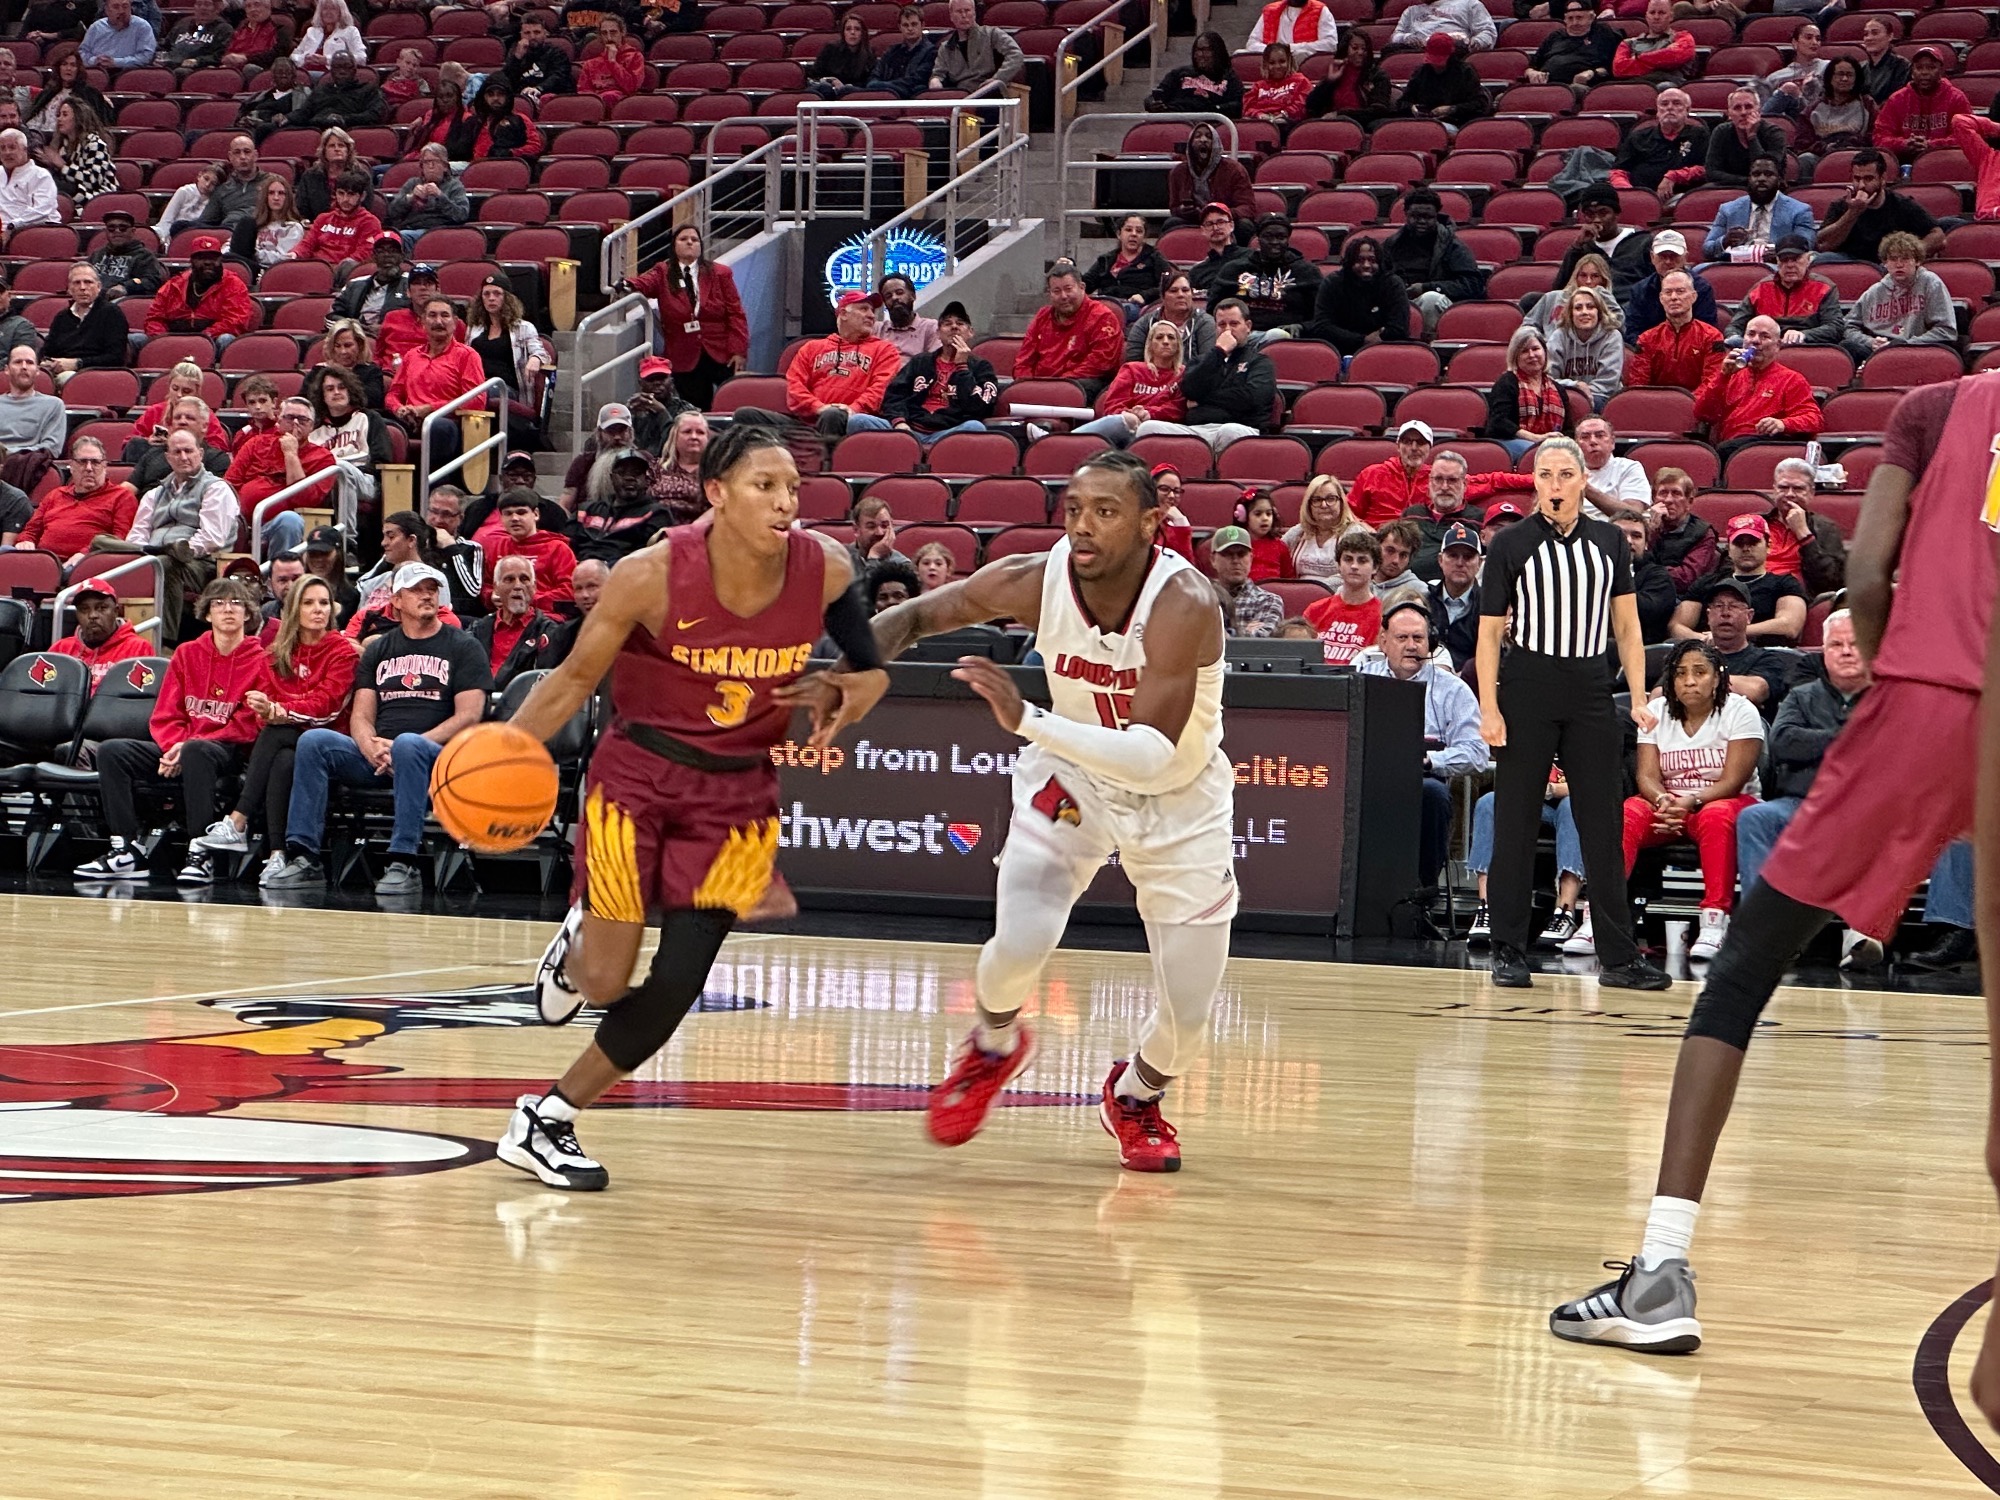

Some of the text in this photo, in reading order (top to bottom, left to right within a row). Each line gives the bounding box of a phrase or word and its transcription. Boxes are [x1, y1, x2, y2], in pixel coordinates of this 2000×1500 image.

[1869, 293, 1926, 323] LOUISVILLE
[1328, 621, 1358, 635] 2013
[1337, 633, 1350, 643] OF
[1350, 635, 1366, 646] THE
[671, 643, 813, 678] SIMMONS
[1323, 645, 1359, 660] RDINA
[376, 654, 449, 686] CARDINALS
[379, 690, 441, 701] LOUISVILLE
[706, 680, 755, 729] 3
[769, 740, 845, 775] stop
[854, 740, 940, 773] from
[1232, 755, 1329, 788] cities
[1661, 748, 1727, 772] OUISVILLE
[777, 801, 944, 855] thwest
[1634, 897, 1647, 905] 63
